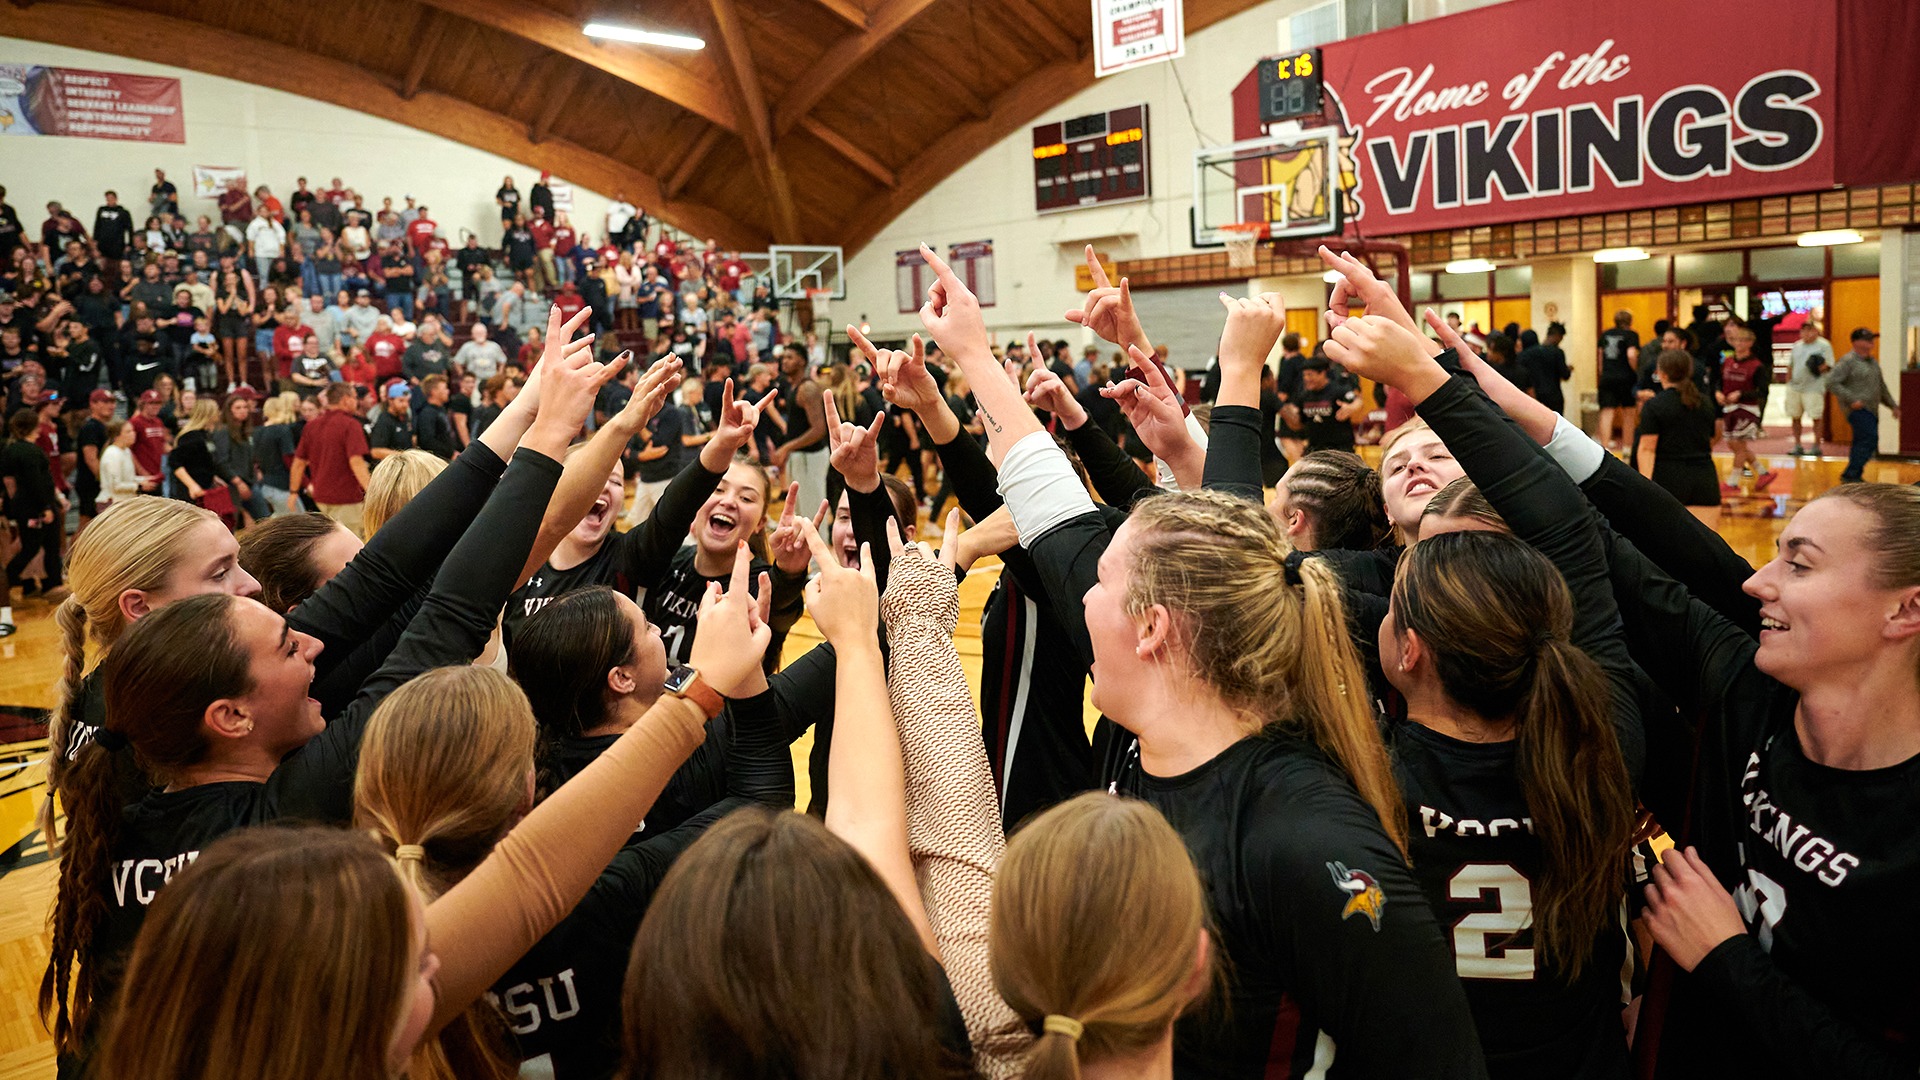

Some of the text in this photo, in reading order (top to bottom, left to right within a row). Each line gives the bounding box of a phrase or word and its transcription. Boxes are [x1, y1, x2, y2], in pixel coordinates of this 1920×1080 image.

[1364, 39, 1632, 128] Home of the
[1366, 69, 1823, 216] VIKINGS
[1448, 863, 1537, 981] 2
[483, 968, 581, 1035] SU
